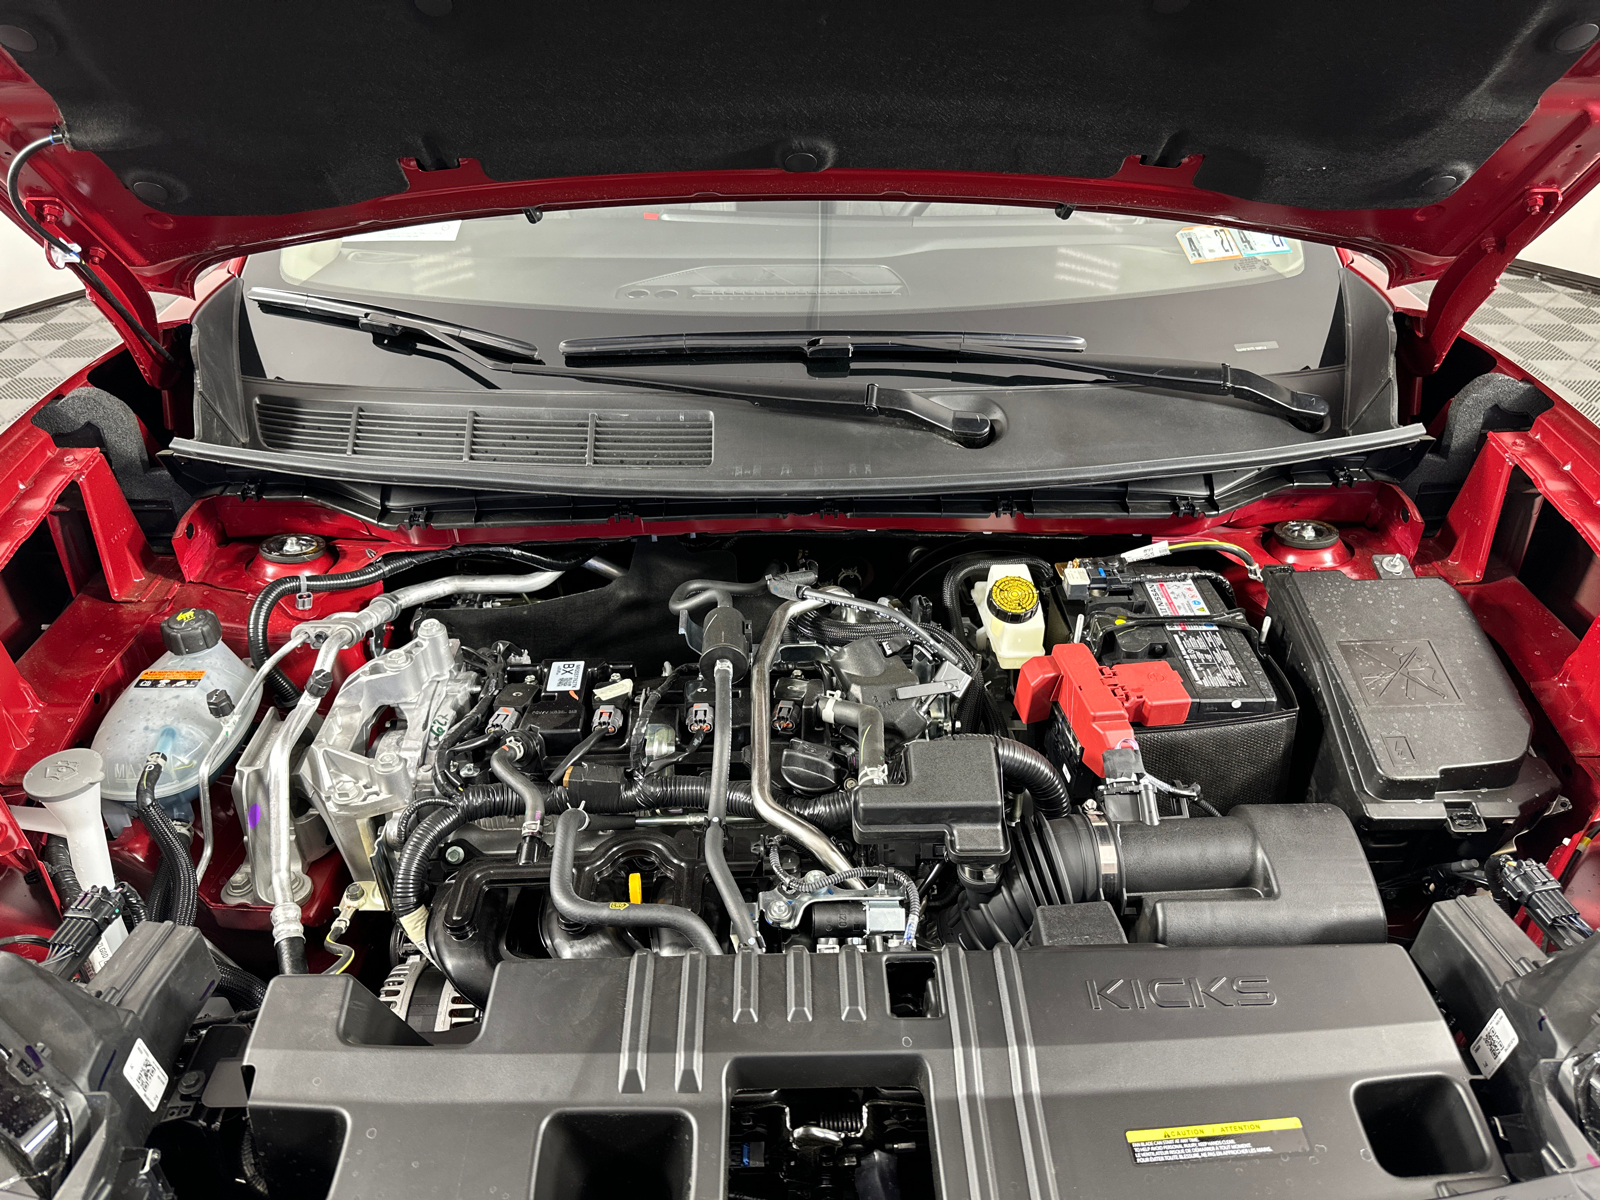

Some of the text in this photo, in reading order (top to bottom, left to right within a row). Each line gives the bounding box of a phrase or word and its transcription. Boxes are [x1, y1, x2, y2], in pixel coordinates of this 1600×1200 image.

[1213, 229, 1234, 253] 27
[1149, 584, 1165, 607] NISSAN
[561, 663, 576, 675] BX
[1085, 976, 1277, 1010] KICKS
[1170, 1128, 1205, 1138] CAUTION
[1220, 1123, 1261, 1133] ATTENTION
